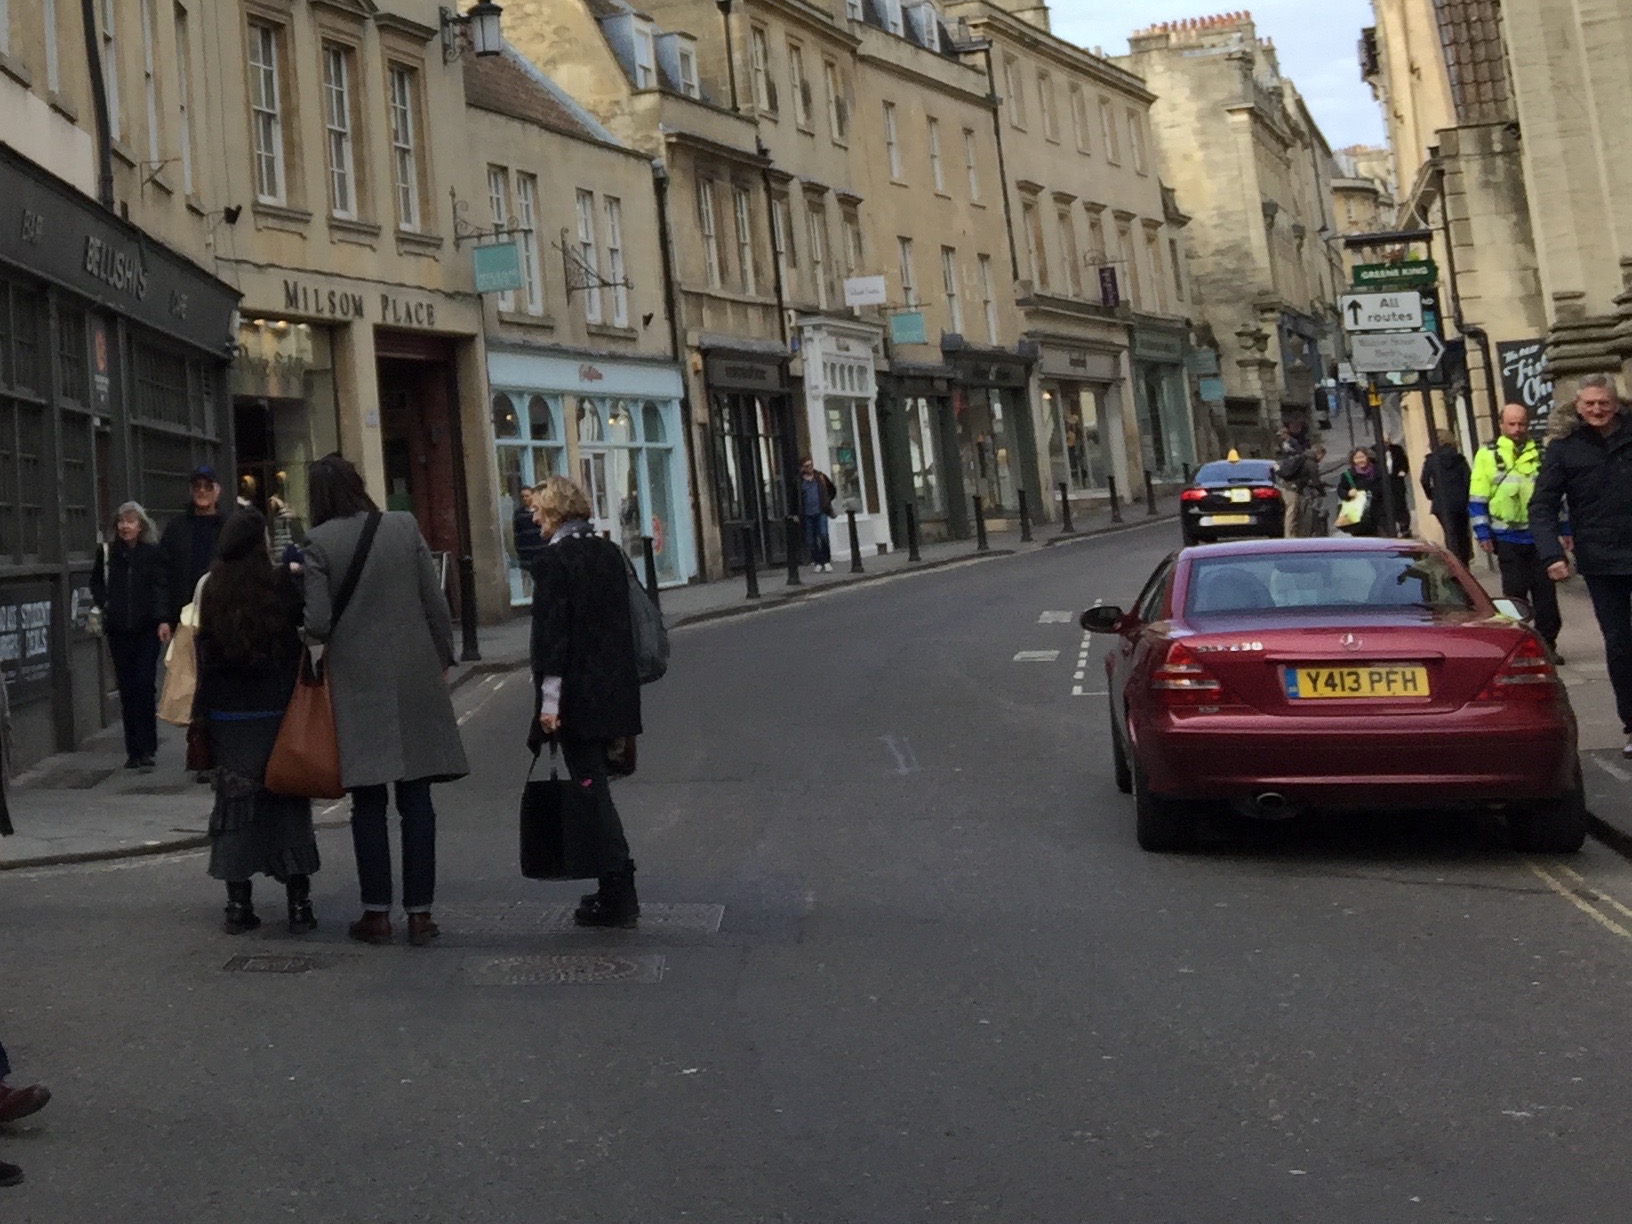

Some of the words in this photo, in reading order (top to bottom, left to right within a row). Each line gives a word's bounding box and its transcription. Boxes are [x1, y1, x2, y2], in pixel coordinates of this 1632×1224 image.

[84, 235, 148, 301] BELUSHI'S
[283, 279, 364, 318] MILSOM
[381, 294, 435, 326] PLACE
[1380, 298, 1399, 308] All
[1368, 312, 1413, 322] routes
[1306, 671, 1362, 693] Y413
[1369, 670, 1418, 692] PFH
